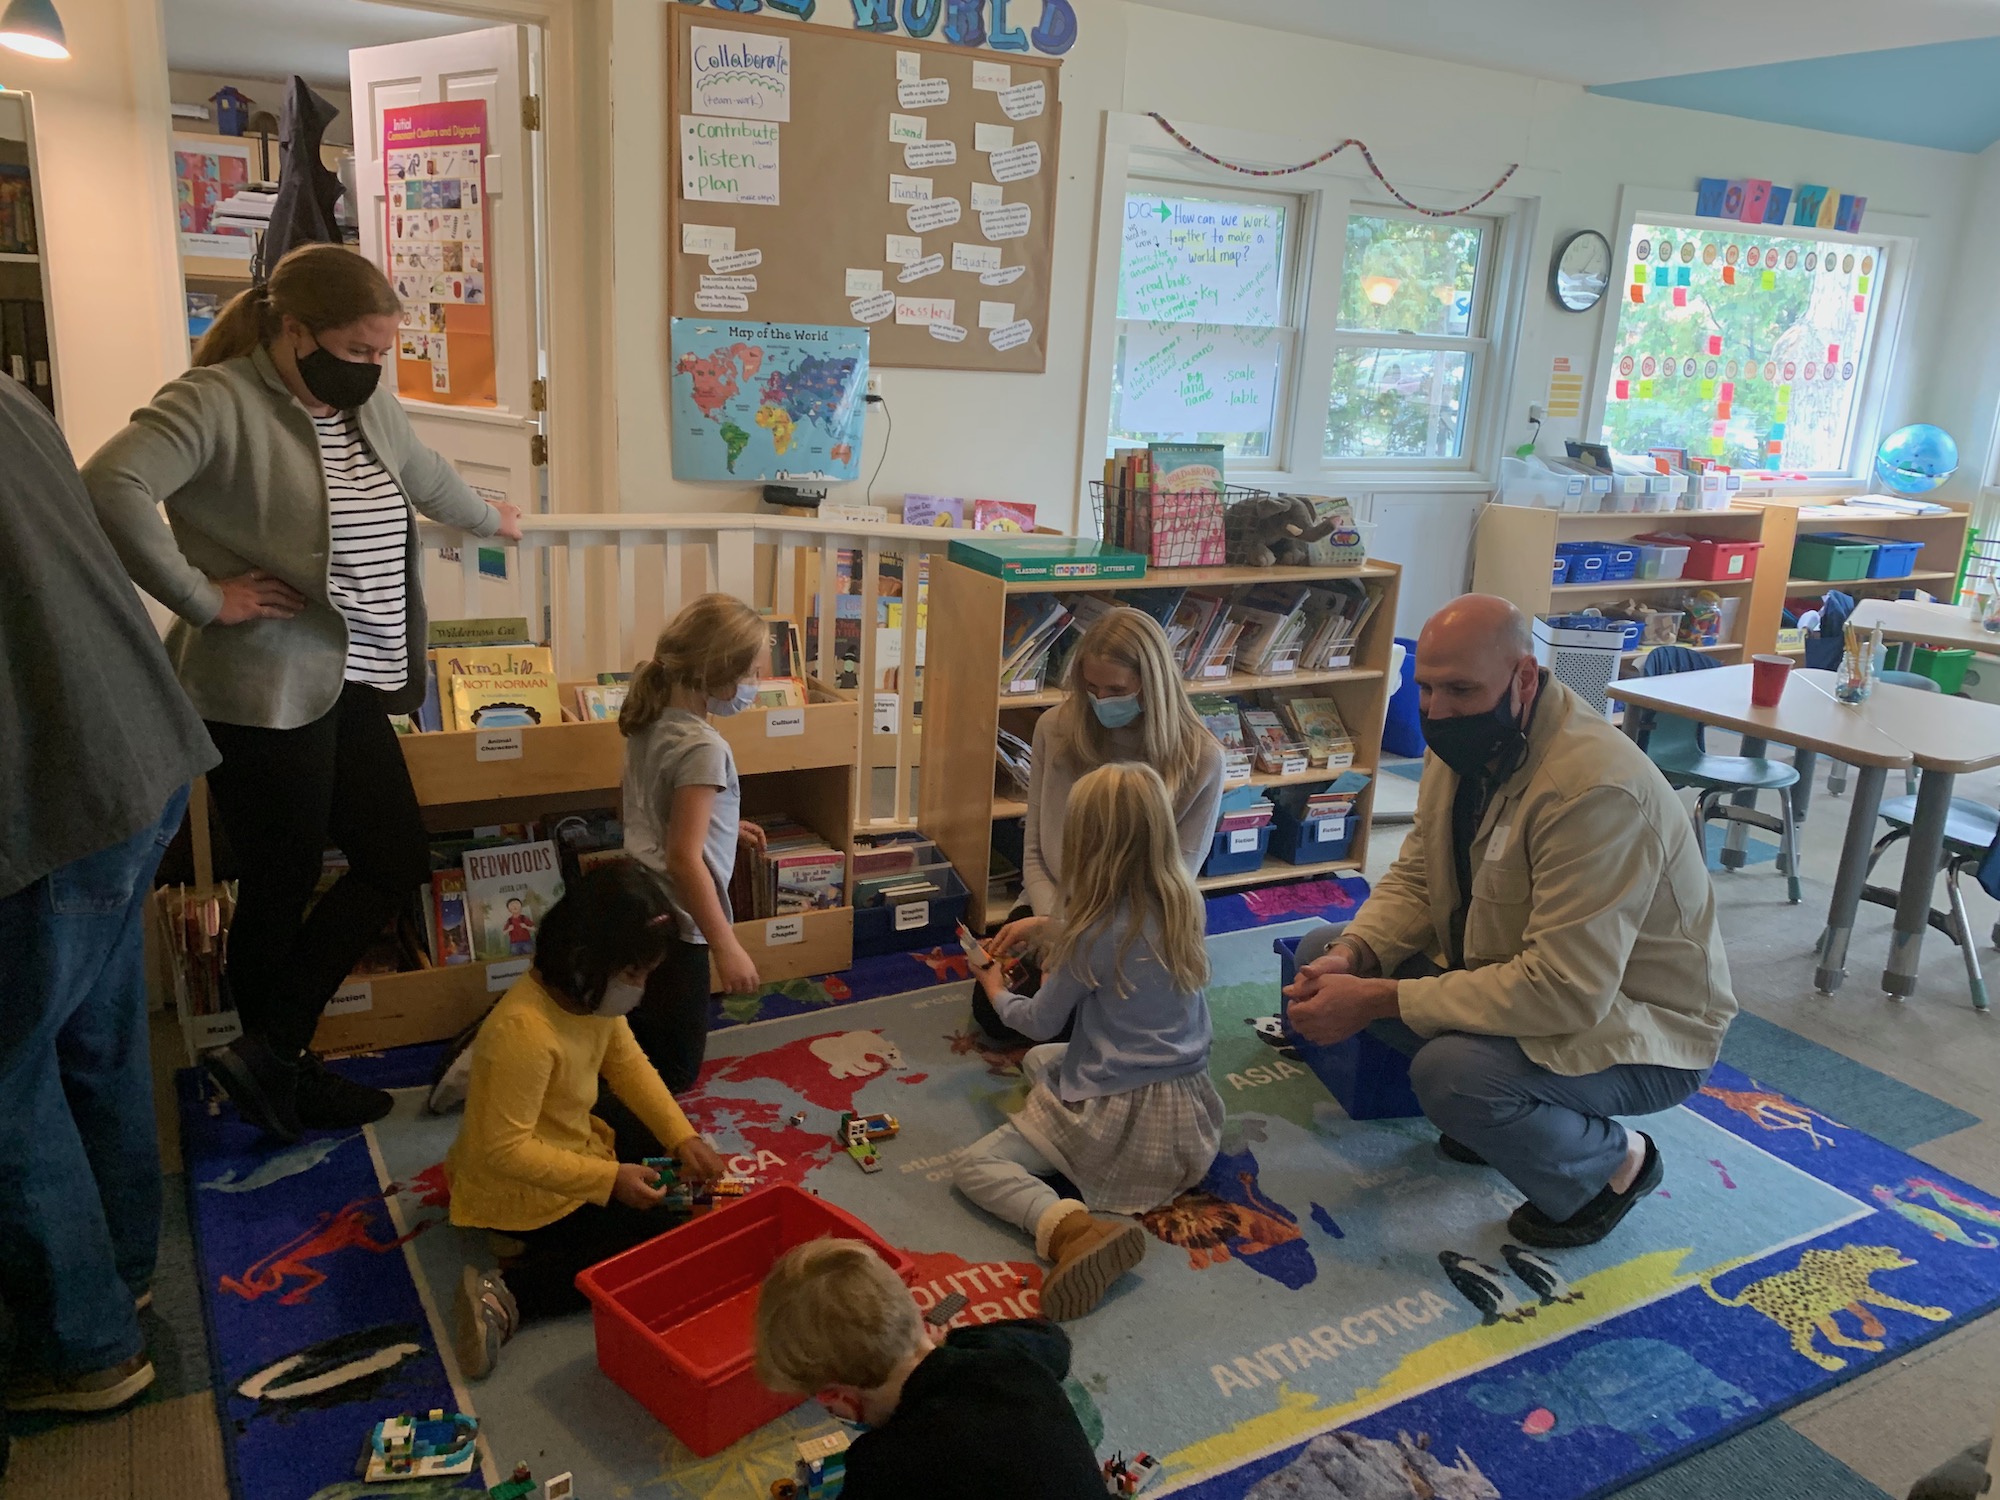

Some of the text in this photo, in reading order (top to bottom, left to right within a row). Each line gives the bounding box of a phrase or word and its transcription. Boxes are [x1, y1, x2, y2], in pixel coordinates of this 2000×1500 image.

[694, 43, 788, 75] Collaborate
[393, 118, 412, 131] Initial
[439, 127, 452, 136] and
[698, 145, 755, 168] listen
[698, 174, 738, 196] plan
[891, 181, 929, 200] Tundra
[1128, 202, 1271, 228] DQ How can we work
[1166, 228, 1264, 251] together to make a
[954, 249, 998, 270] Aquatic
[1188, 245, 1250, 267] world map?
[729, 326, 829, 341] Map of the World
[1055, 564, 1096, 576] magnetic
[448, 653, 542, 675] Armadill
[463, 678, 549, 689] NOT NORMAN
[481, 743, 518, 751] Characters
[469, 847, 552, 881] REDWOODS
[775, 923, 794, 931] Short
[207, 1024, 236, 1034] Math
[1225, 1060, 1306, 1091] ASIA
[909, 1262, 1017, 1309] OUTH
[1209, 1288, 1460, 1397] ANTARCTICA
